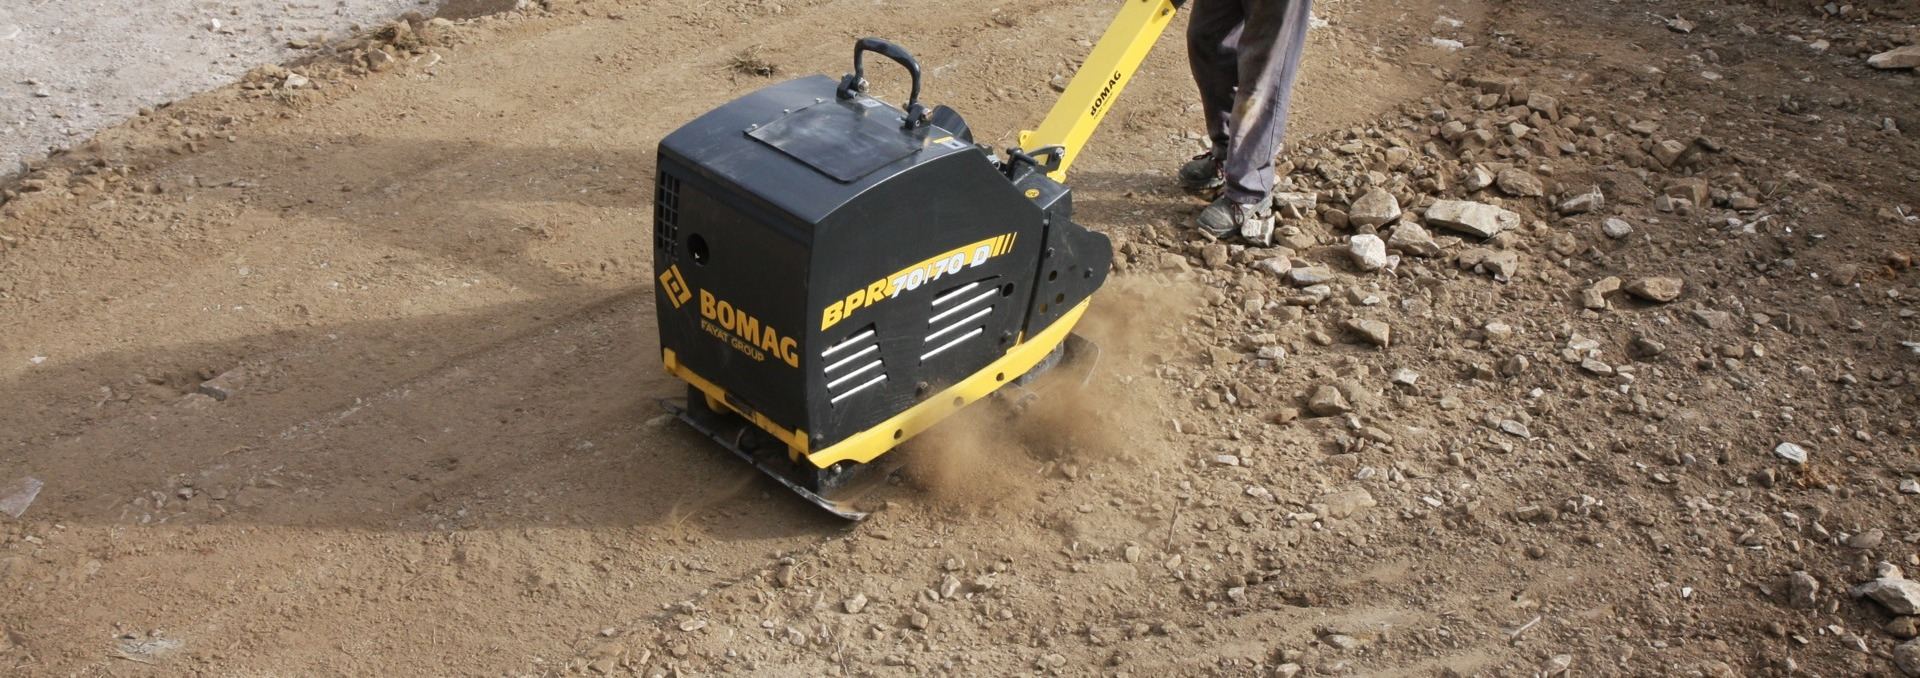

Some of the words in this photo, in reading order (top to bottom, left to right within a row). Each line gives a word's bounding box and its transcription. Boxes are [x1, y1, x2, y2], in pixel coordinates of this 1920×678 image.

[1090, 70, 1121, 116] BOMAG
[821, 277, 888, 331] BPR
[891, 252, 964, 298] 70/70
[970, 245, 990, 268] D
[700, 288, 798, 368] BOMAG
[701, 320, 729, 343] FAYAT
[731, 336, 765, 362] GROUP
